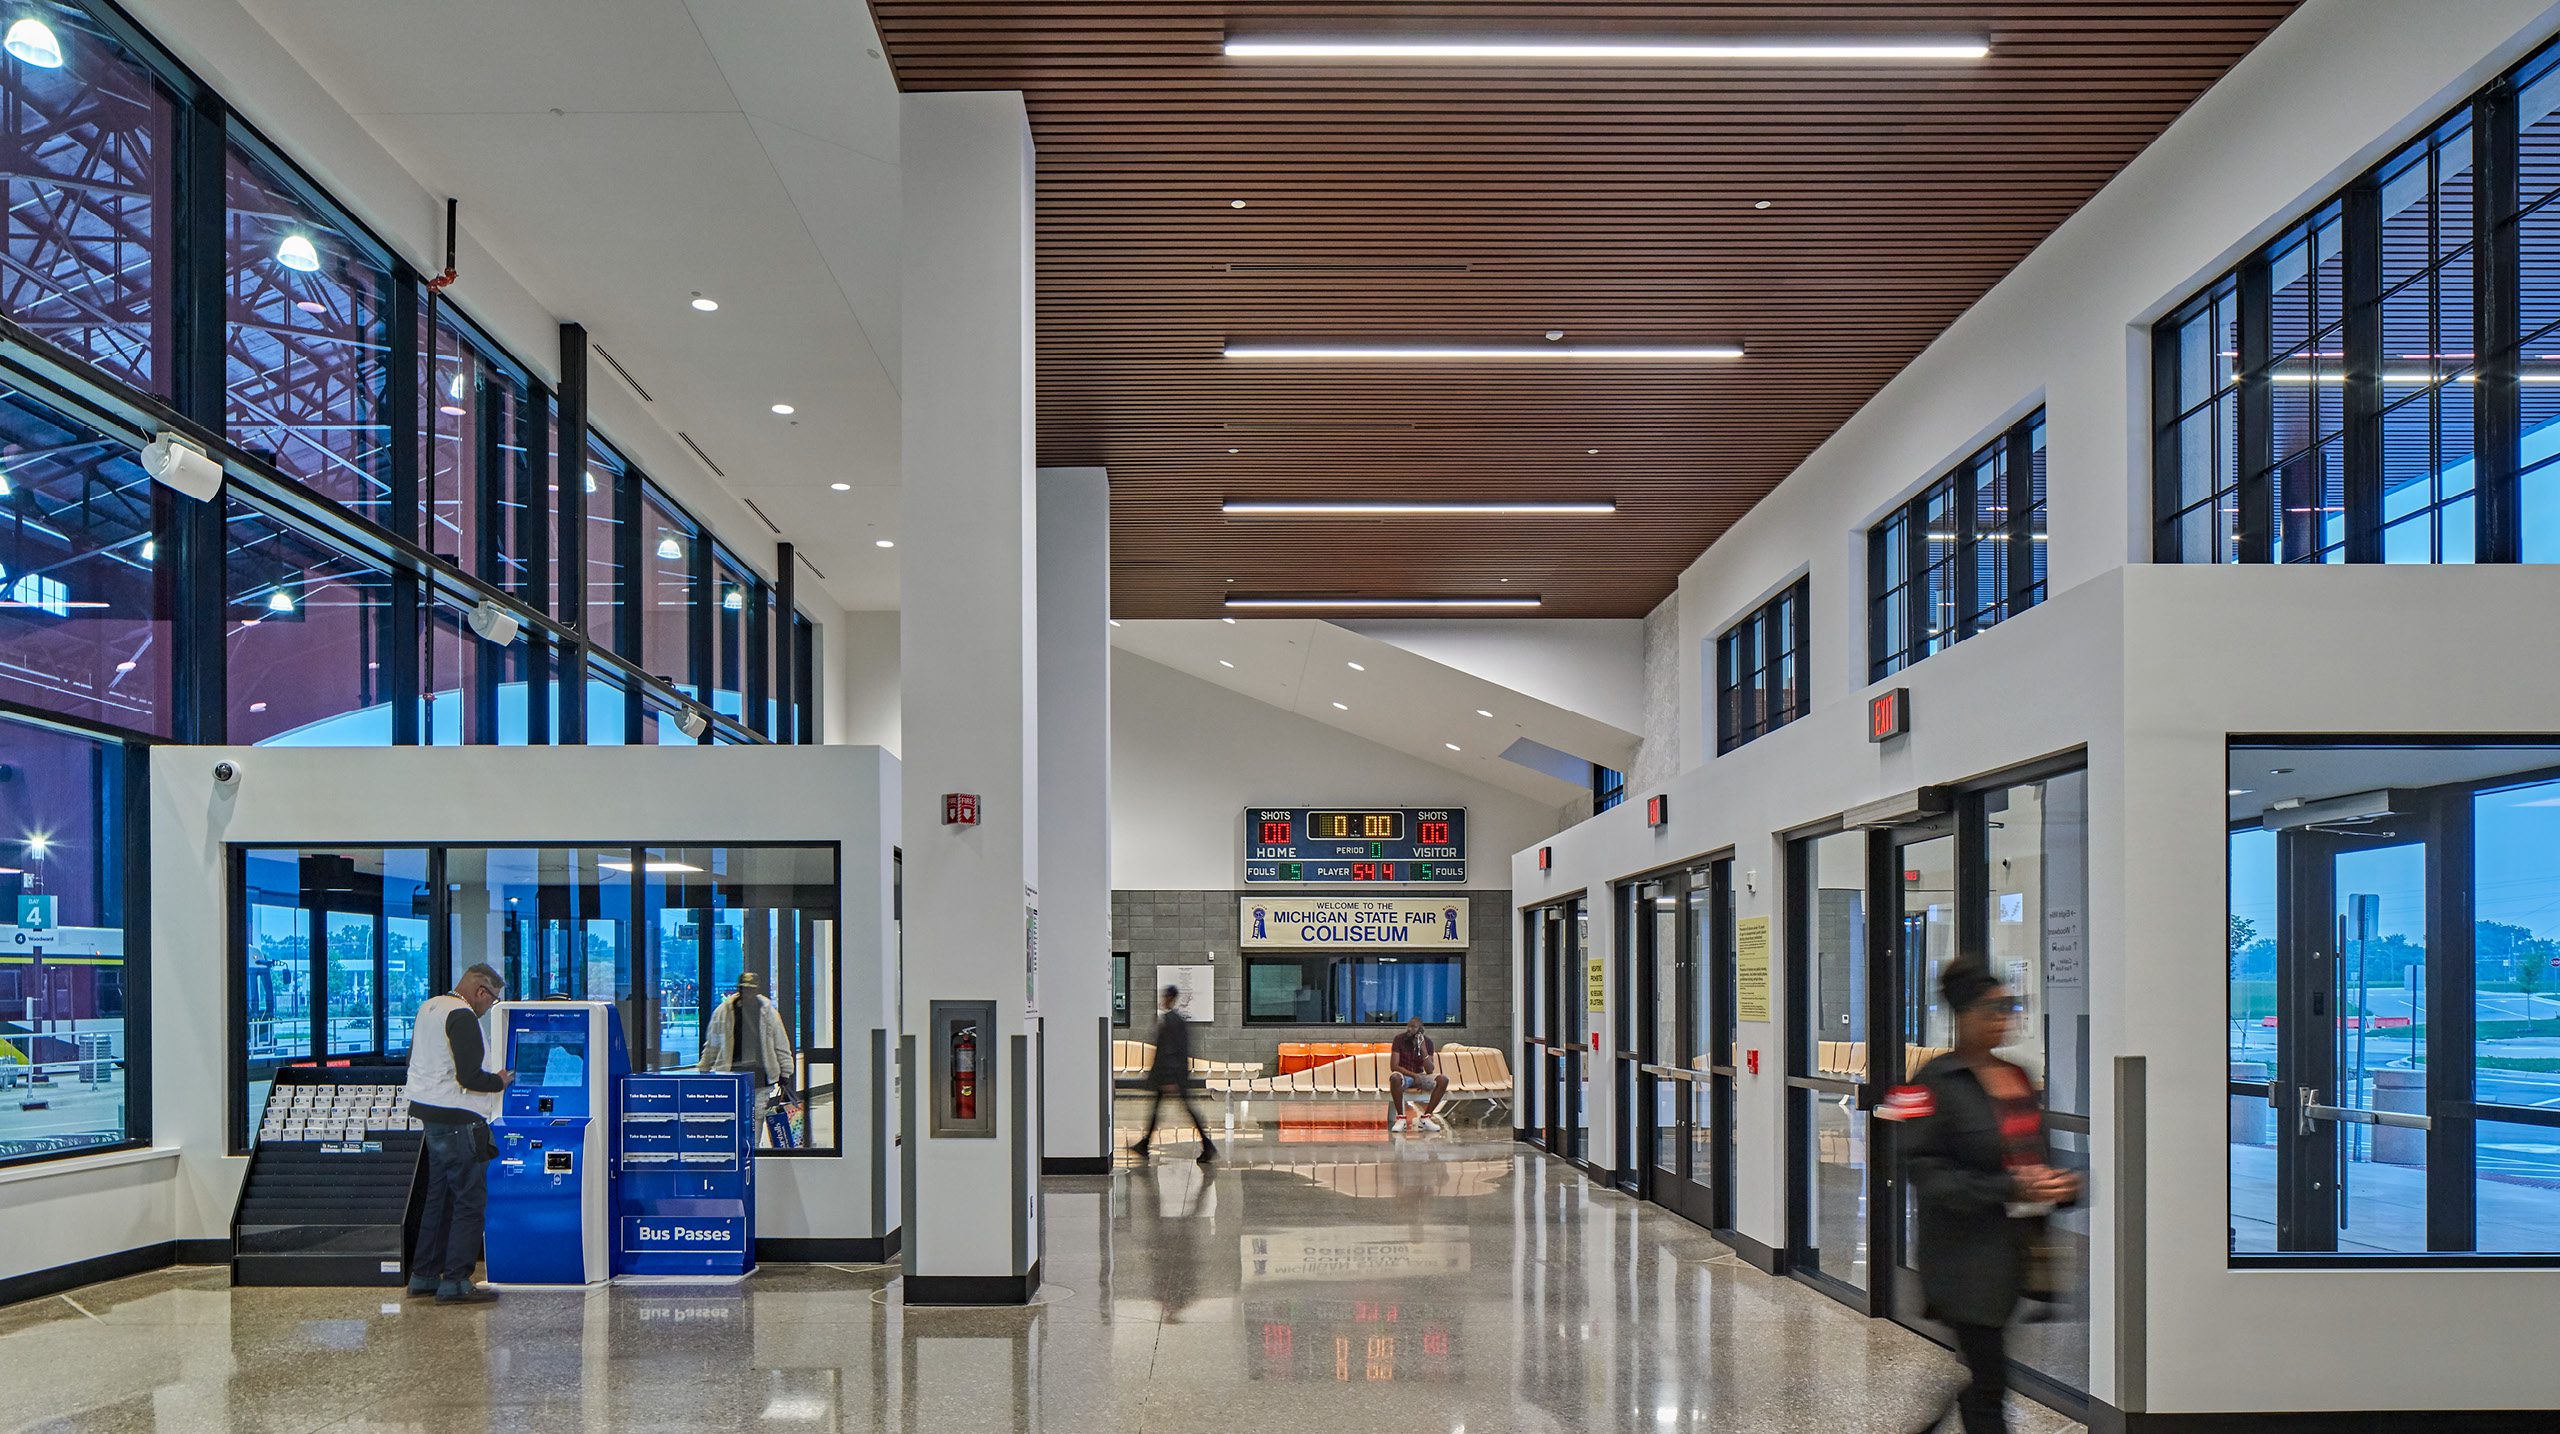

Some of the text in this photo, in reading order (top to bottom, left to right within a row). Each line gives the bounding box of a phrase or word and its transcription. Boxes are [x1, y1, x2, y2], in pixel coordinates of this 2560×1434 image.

[1874, 694, 1894, 737] EXIT
[1260, 811, 1291, 820] SHOTS
[1418, 811, 1448, 820] SHOTS
[1265, 823, 1290, 843] 00
[1256, 847, 1297, 858] HOME
[1371, 842, 1381, 858] 0
[1412, 847, 1457, 858] VISITOR
[1247, 867, 1276, 876] FOULS
[1291, 863, 1301, 880] 5
[1317, 867, 1350, 876] PLAYER
[1422, 863, 1432, 880] 5
[1435, 867, 1464, 876] FOULS
[1316, 902, 1393, 910] WELCOME TO THE
[26, 906, 42, 926] 4
[1273, 911, 1436, 924] MICHIGAN STATE FAIR
[1301, 925, 1408, 942] COLISEUM
[639, 1227, 730, 1241] Bus Passes
